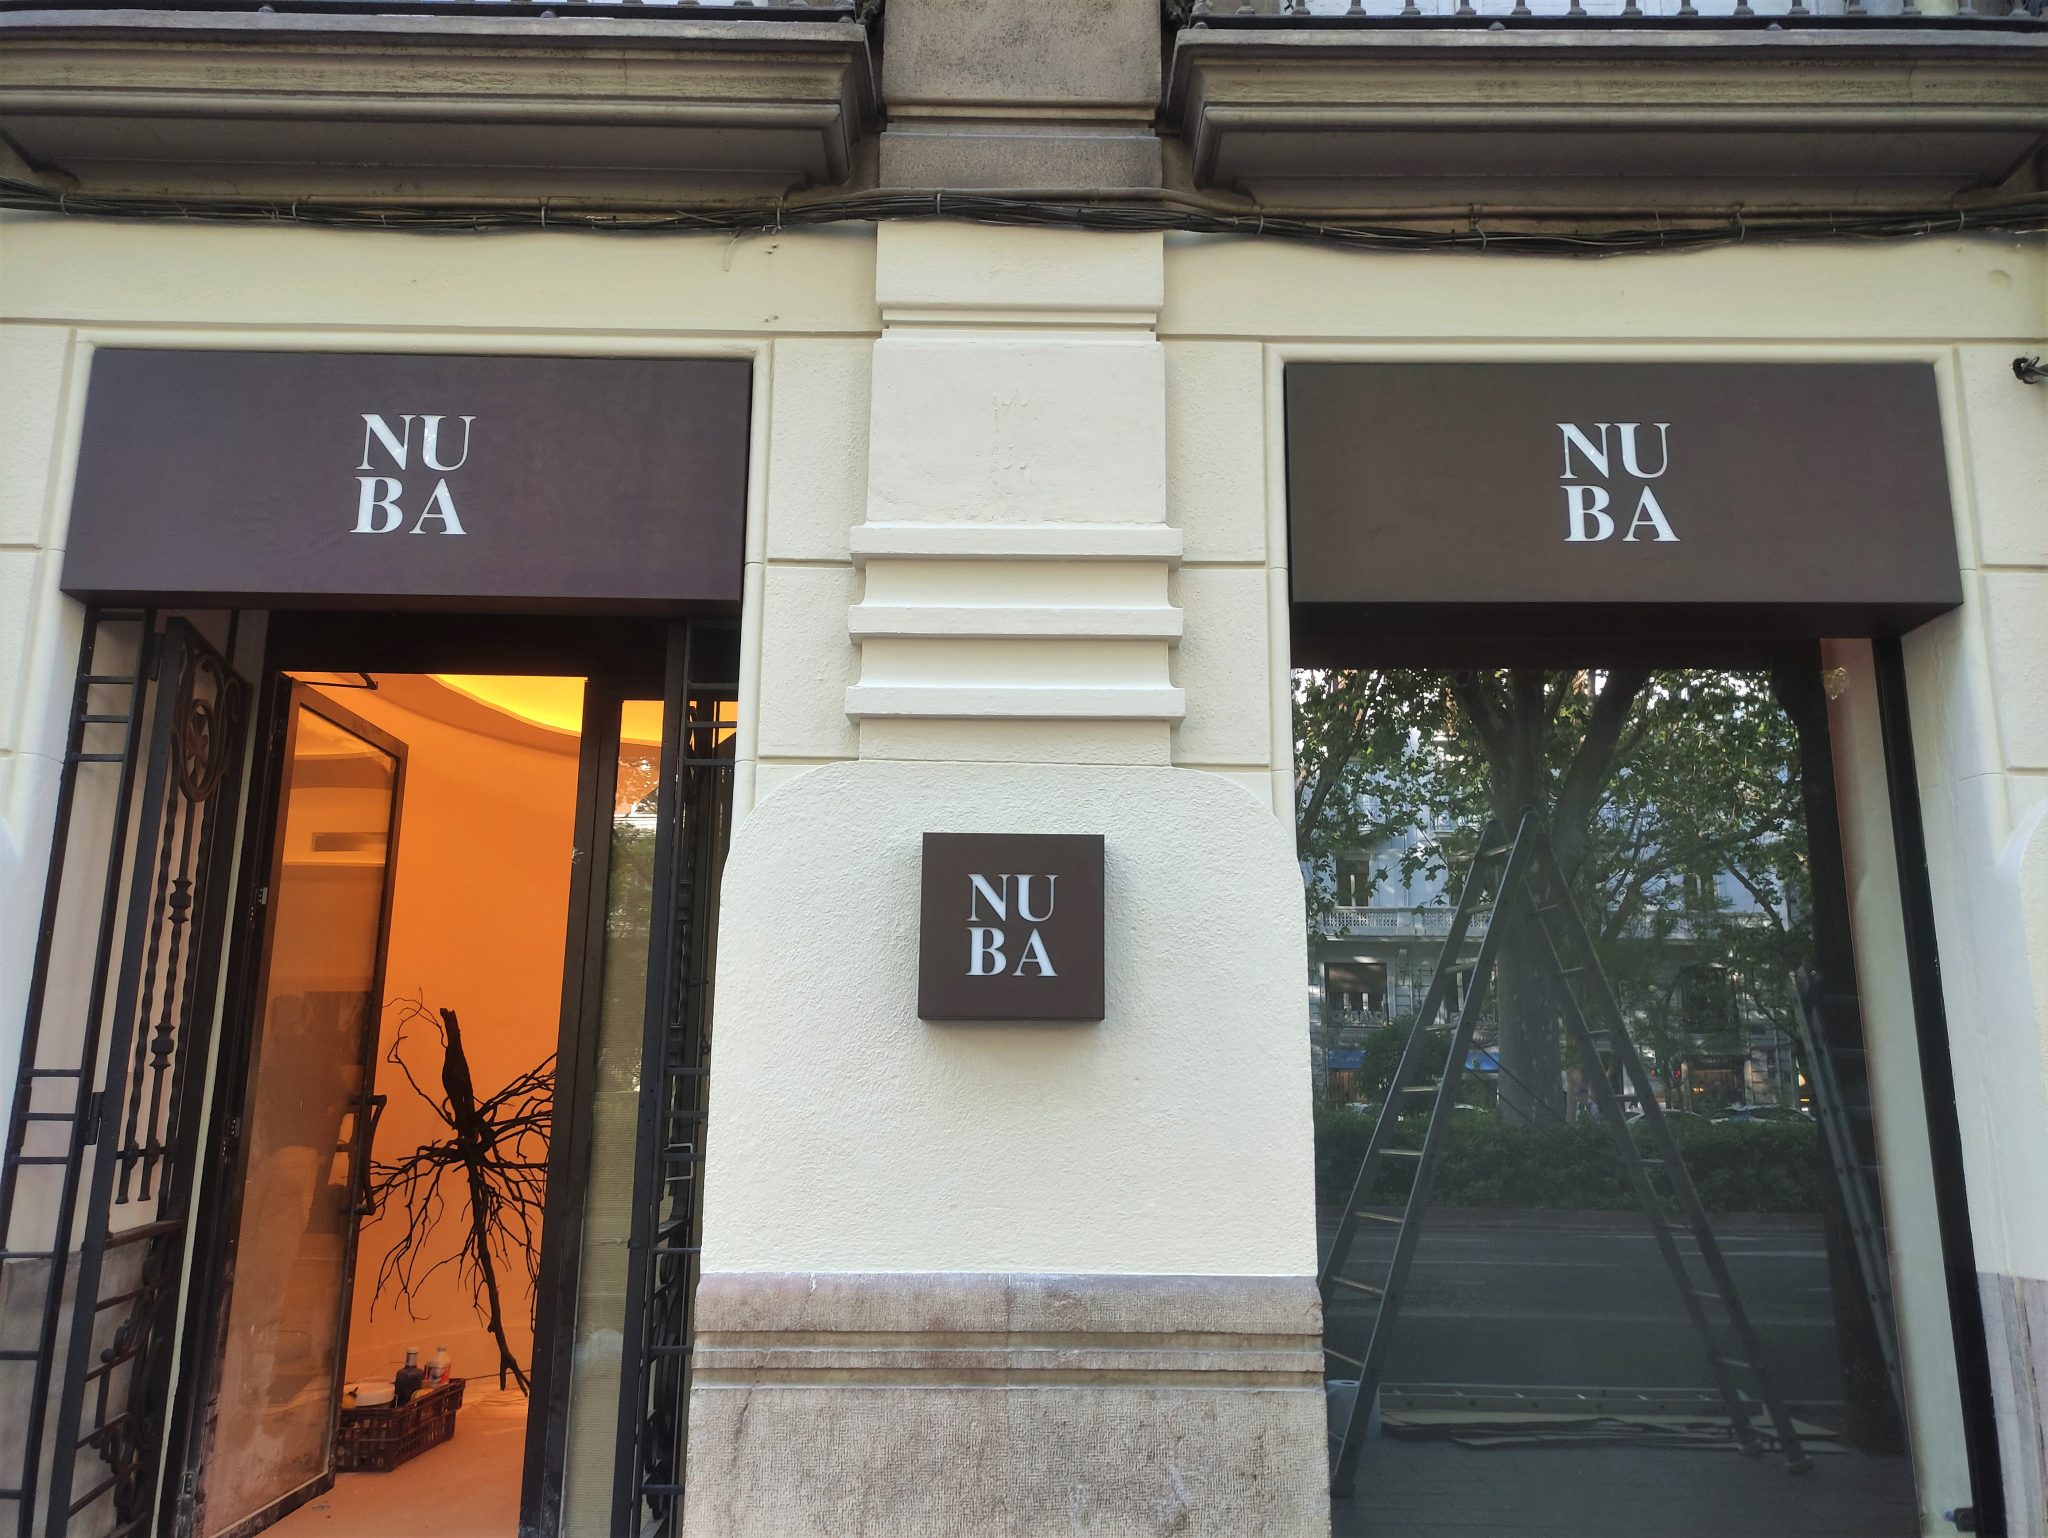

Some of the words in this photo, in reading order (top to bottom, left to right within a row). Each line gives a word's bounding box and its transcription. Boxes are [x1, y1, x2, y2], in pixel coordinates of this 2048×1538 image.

[354, 413, 477, 472] NU
[1555, 422, 1671, 479] NU
[348, 476, 468, 535] BA
[1560, 485, 1681, 542] BA
[967, 873, 1058, 922] NU
[966, 927, 1058, 977] BA
